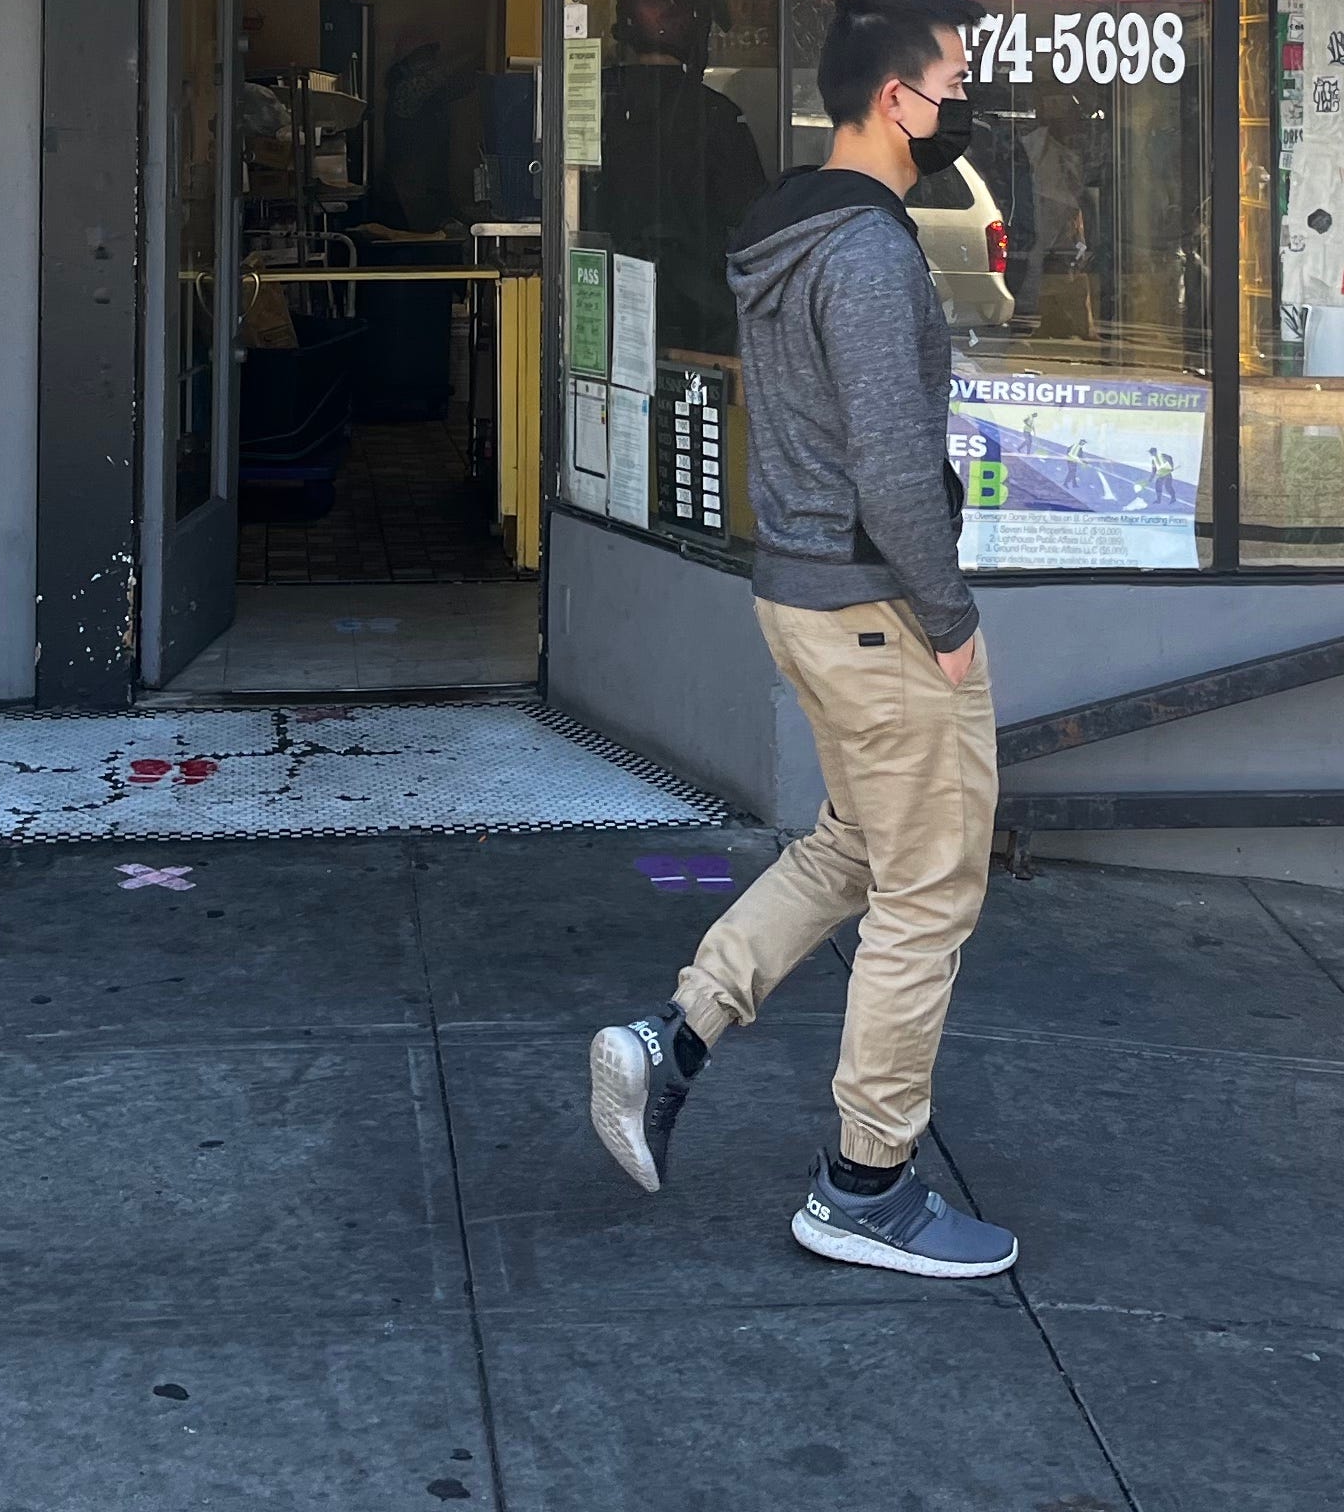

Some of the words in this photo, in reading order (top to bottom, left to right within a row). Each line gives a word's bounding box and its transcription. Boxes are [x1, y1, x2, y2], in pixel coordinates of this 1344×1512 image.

[577, 268, 599, 285] PASS
[949, 379, 1091, 404] OVERSIGHT
[1093, 390, 1143, 406] DONE
[1147, 392, 1200, 408] RIGHT
[946, 434, 987, 457] ES
[967, 460, 1008, 506] B
[1141, 516, 1167, 526] Funding
